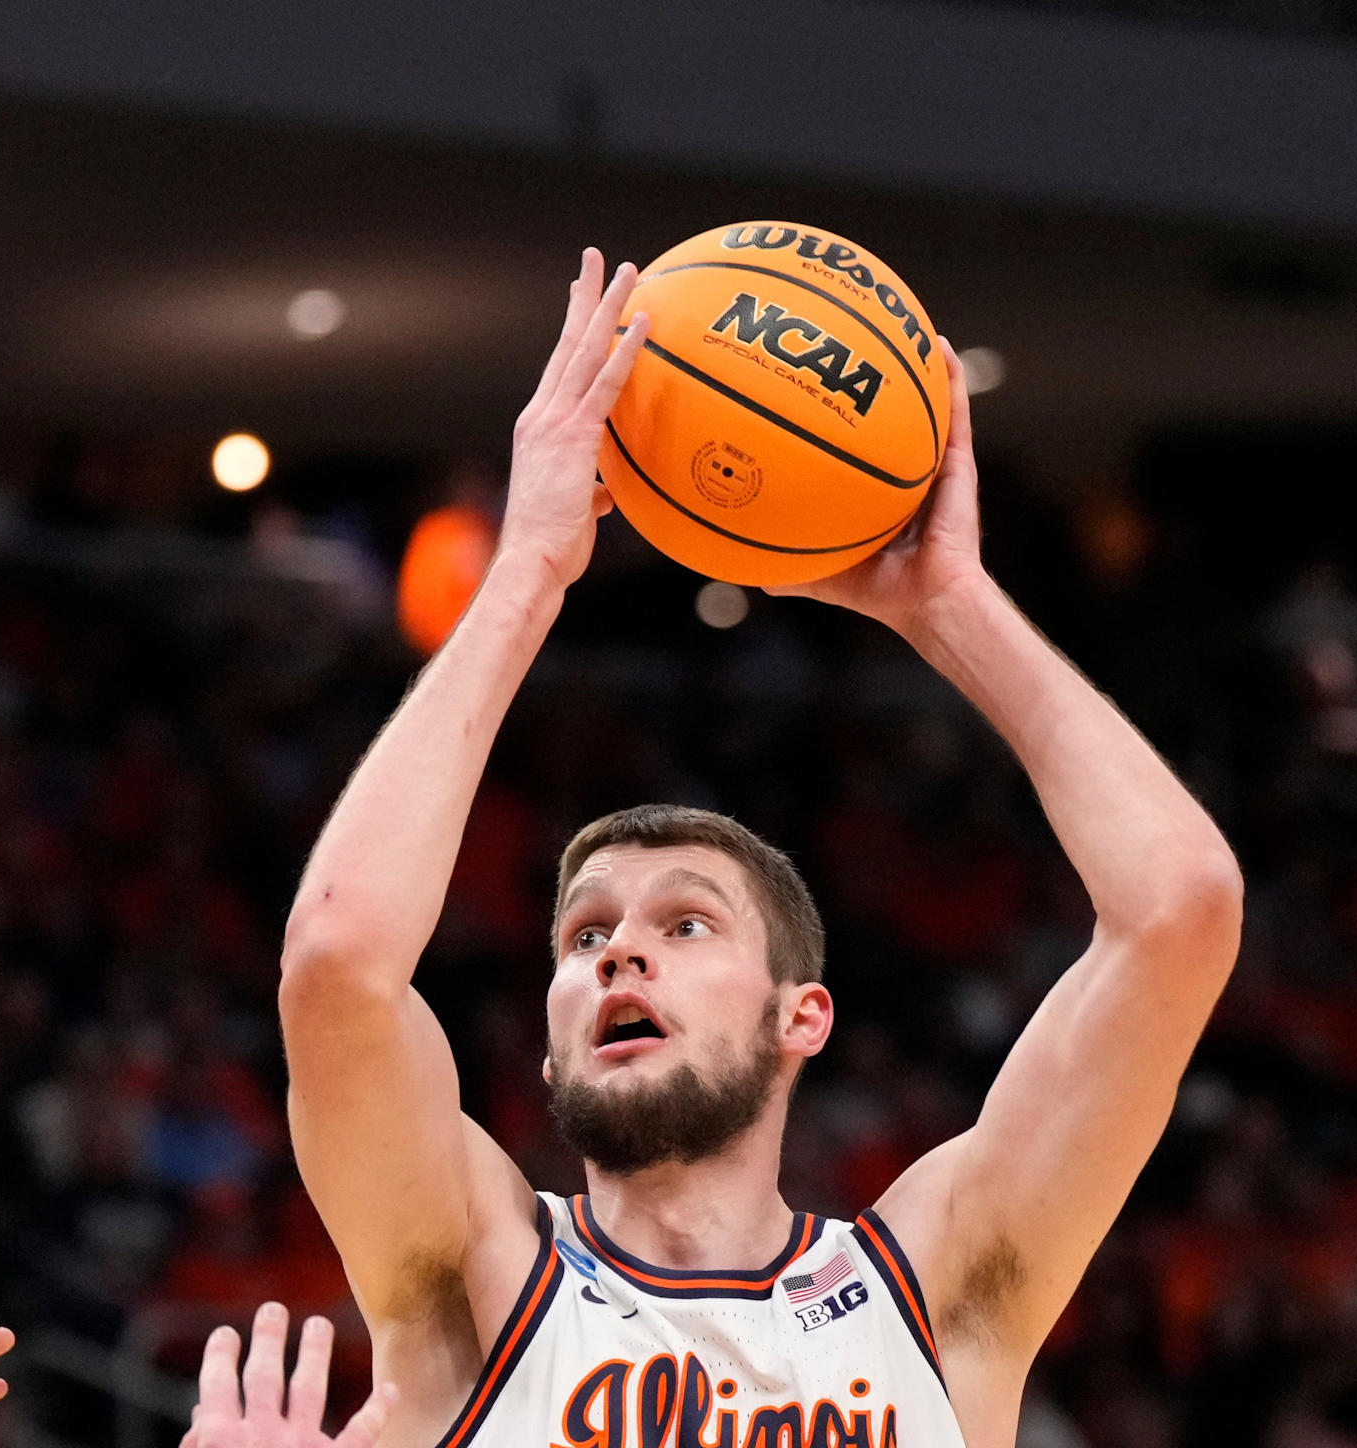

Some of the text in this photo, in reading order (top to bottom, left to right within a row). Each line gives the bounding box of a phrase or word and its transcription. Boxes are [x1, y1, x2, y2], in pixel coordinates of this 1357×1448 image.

[721, 226, 931, 365] Wilson
[802, 262, 870, 301] EVO NXT
[703, 335, 857, 429] OFFICIAL GAME BALL
[710, 292, 885, 417] NCAA
